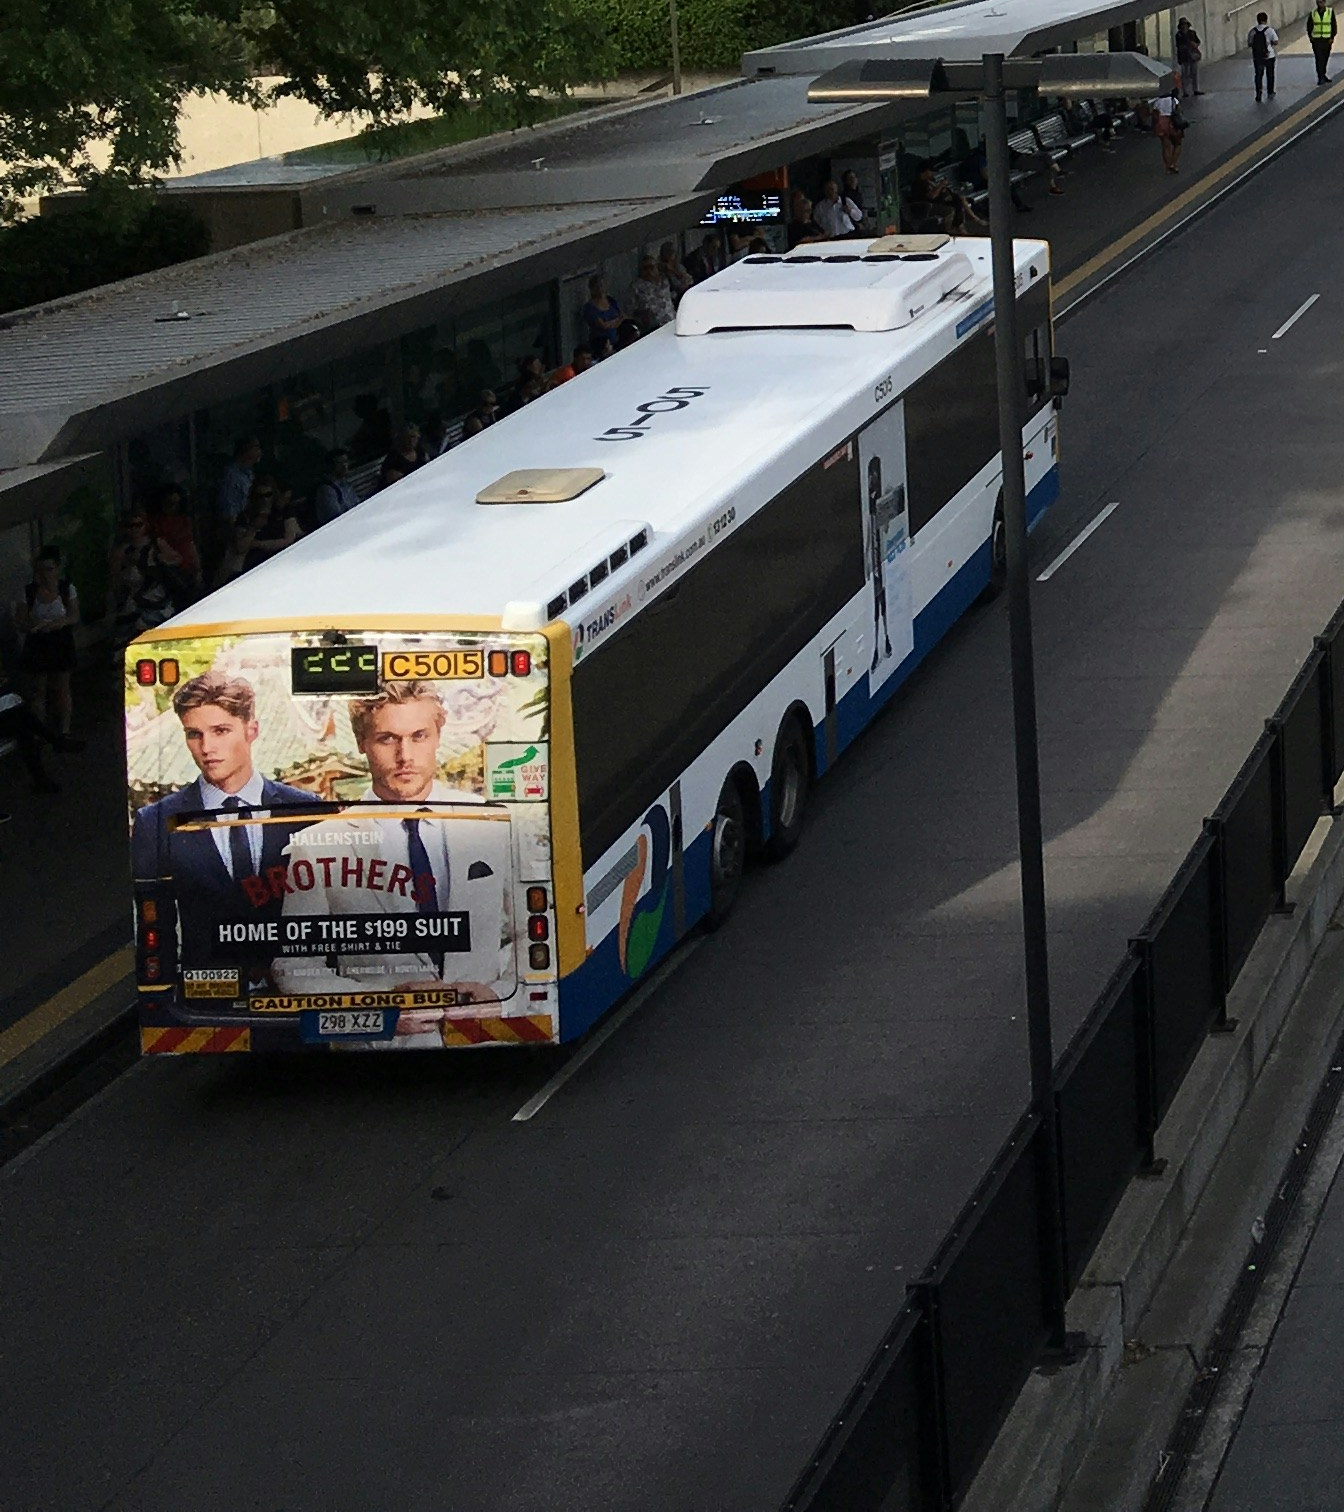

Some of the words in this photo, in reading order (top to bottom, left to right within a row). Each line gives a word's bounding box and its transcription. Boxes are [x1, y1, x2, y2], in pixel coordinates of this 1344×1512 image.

[388, 652, 481, 677] C5015
[520, 764, 548, 773] GIVE
[521, 773, 546, 782] WAY
[288, 831, 384, 846] HALLENSTEIN
[240, 856, 437, 908] BROTHERS
[218, 922, 279, 943] HOME
[286, 921, 312, 940] OF
[318, 919, 358, 938] THE
[364, 919, 408, 937] $199
[415, 917, 462, 937] SUIT
[282, 944, 307, 953] WITH
[312, 943, 337, 952] FREE
[340, 942, 370, 952] SHIRT
[375, 942, 382, 950] &
[385, 941, 401, 950] TIE
[184, 968, 238, 981] Q100922
[251, 996, 343, 1011] CAUTION
[350, 993, 408, 1007] LONG
[412, 991, 456, 1005] BUS
[320, 1012, 346, 1030] 298
[352, 1011, 382, 1028] XZZ
